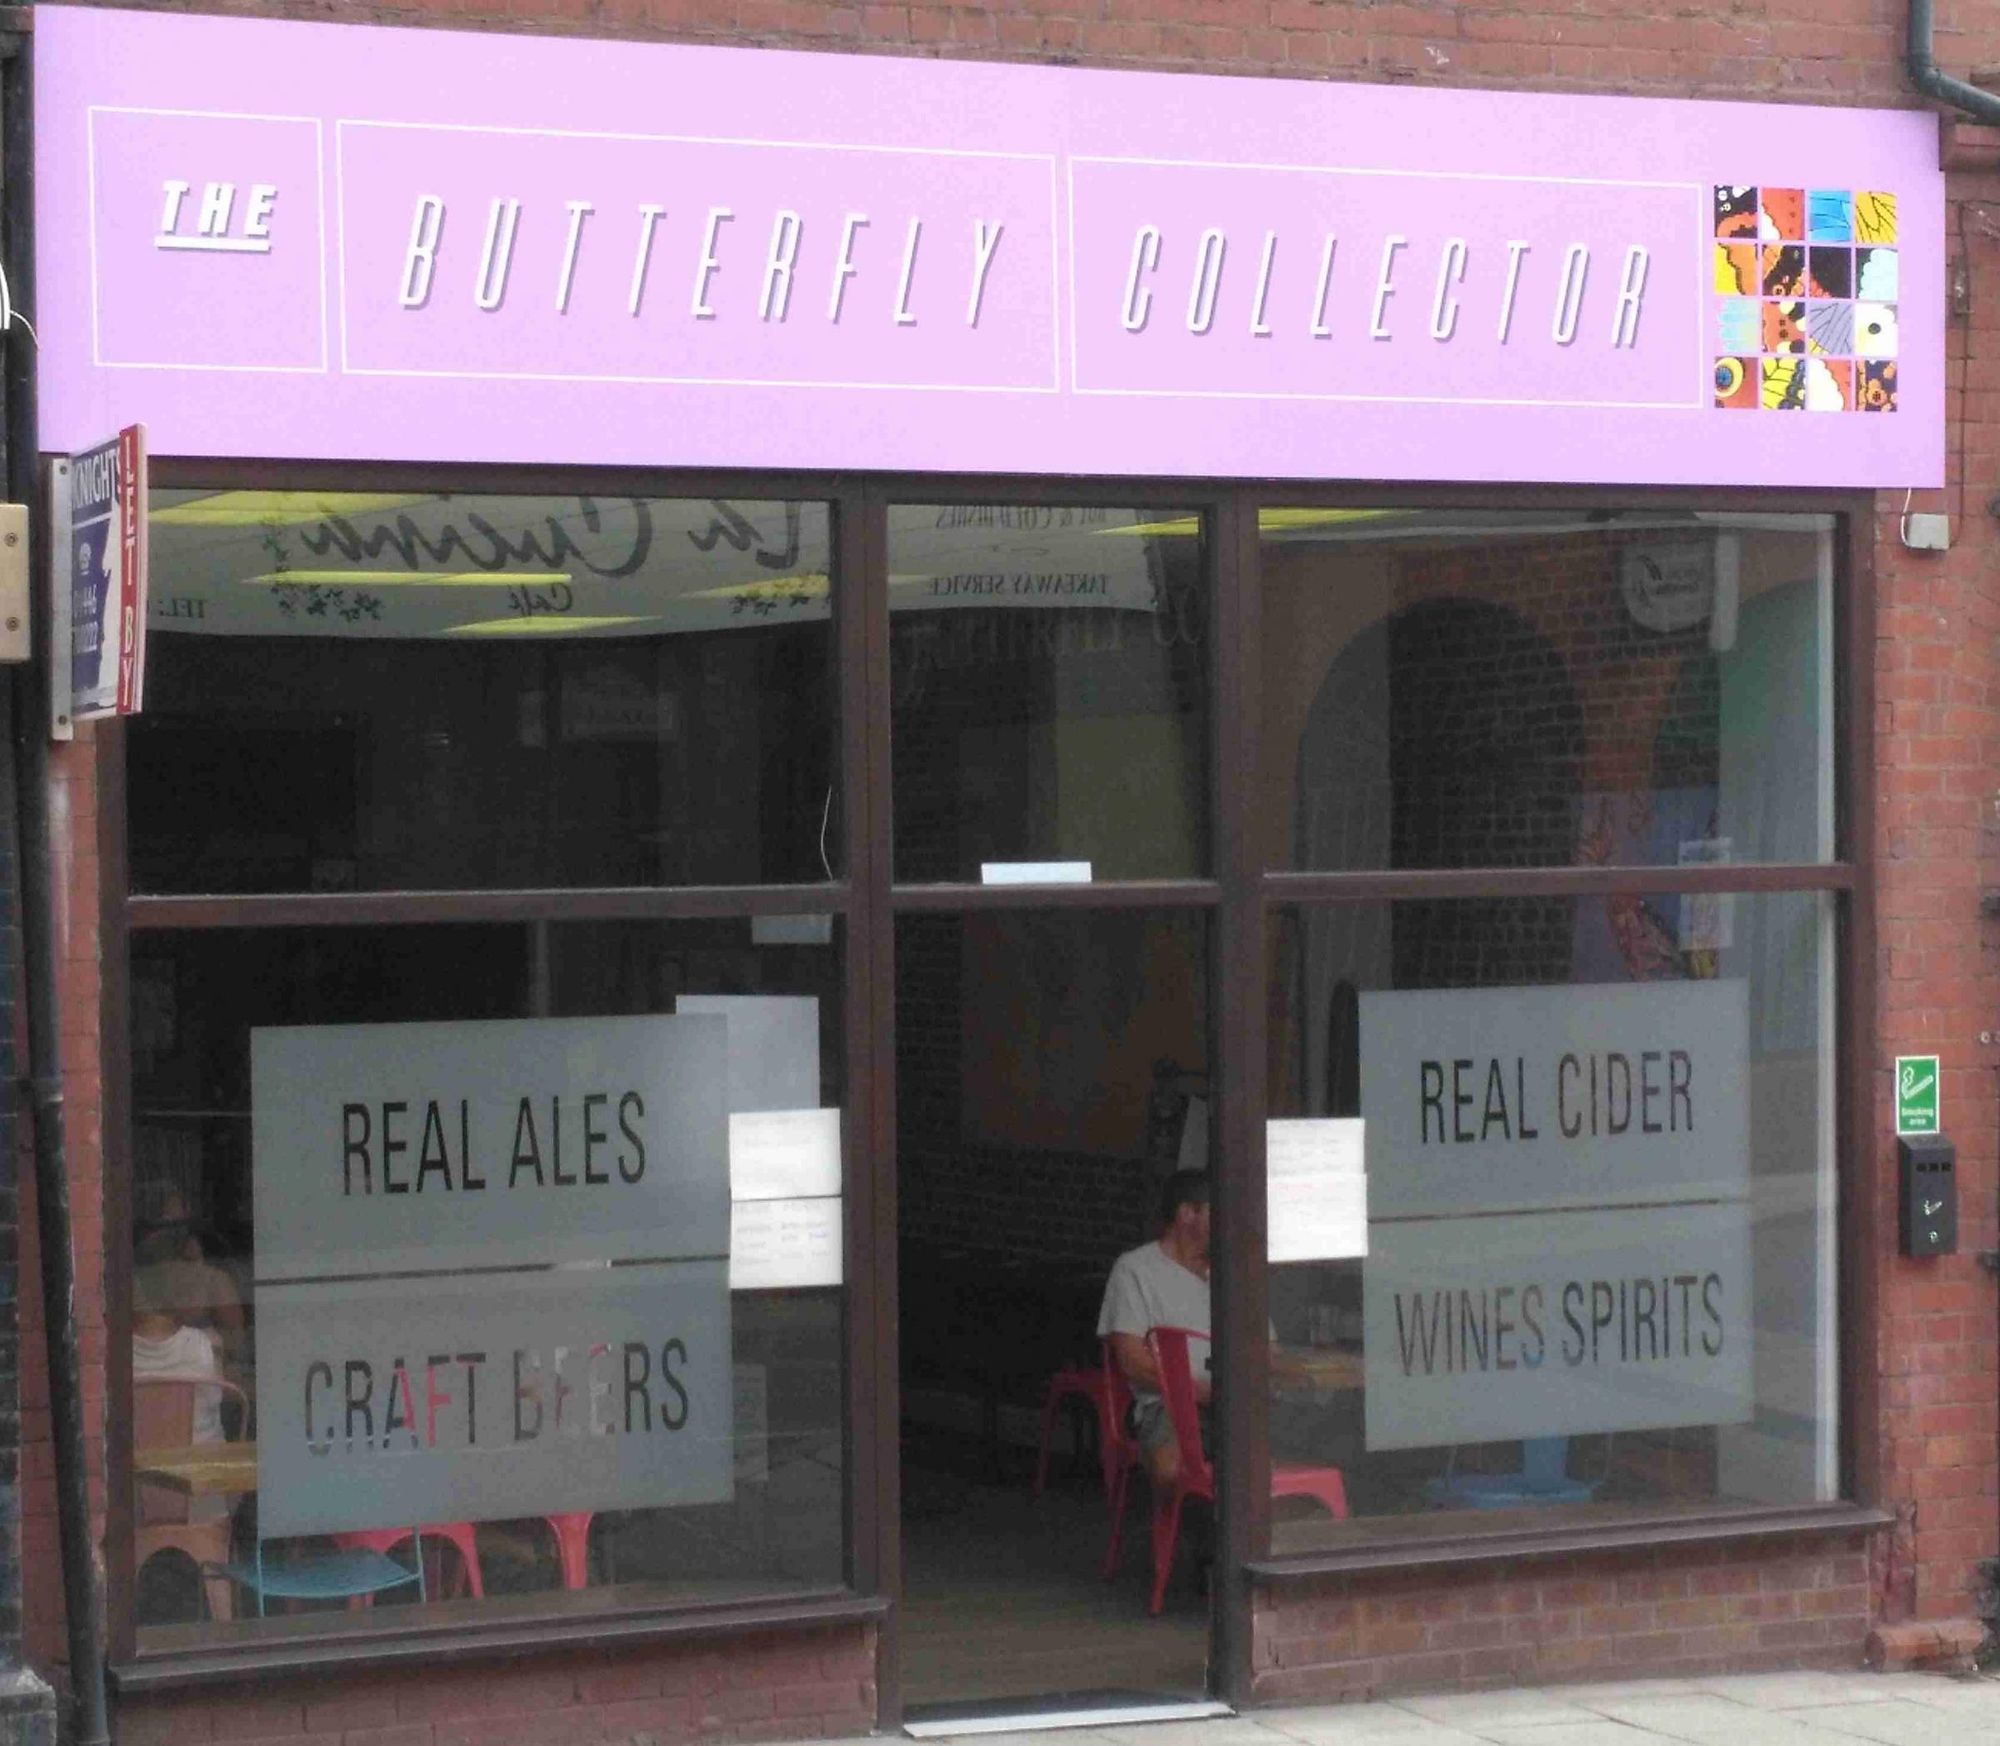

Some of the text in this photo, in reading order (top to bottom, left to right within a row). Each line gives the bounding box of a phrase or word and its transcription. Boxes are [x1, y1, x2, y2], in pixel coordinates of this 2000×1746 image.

[160, 179, 279, 240] THE
[398, 194, 1004, 329] BUTTERFLY
[1119, 223, 1651, 348] COLLECTOR
[343, 1091, 647, 1196] REAL ALES
[1420, 1050, 1694, 1144] REAL CIDER
[1394, 1273, 1724, 1377] WINES SPIRITS
[305, 1352, 487, 1456] CRAFT
